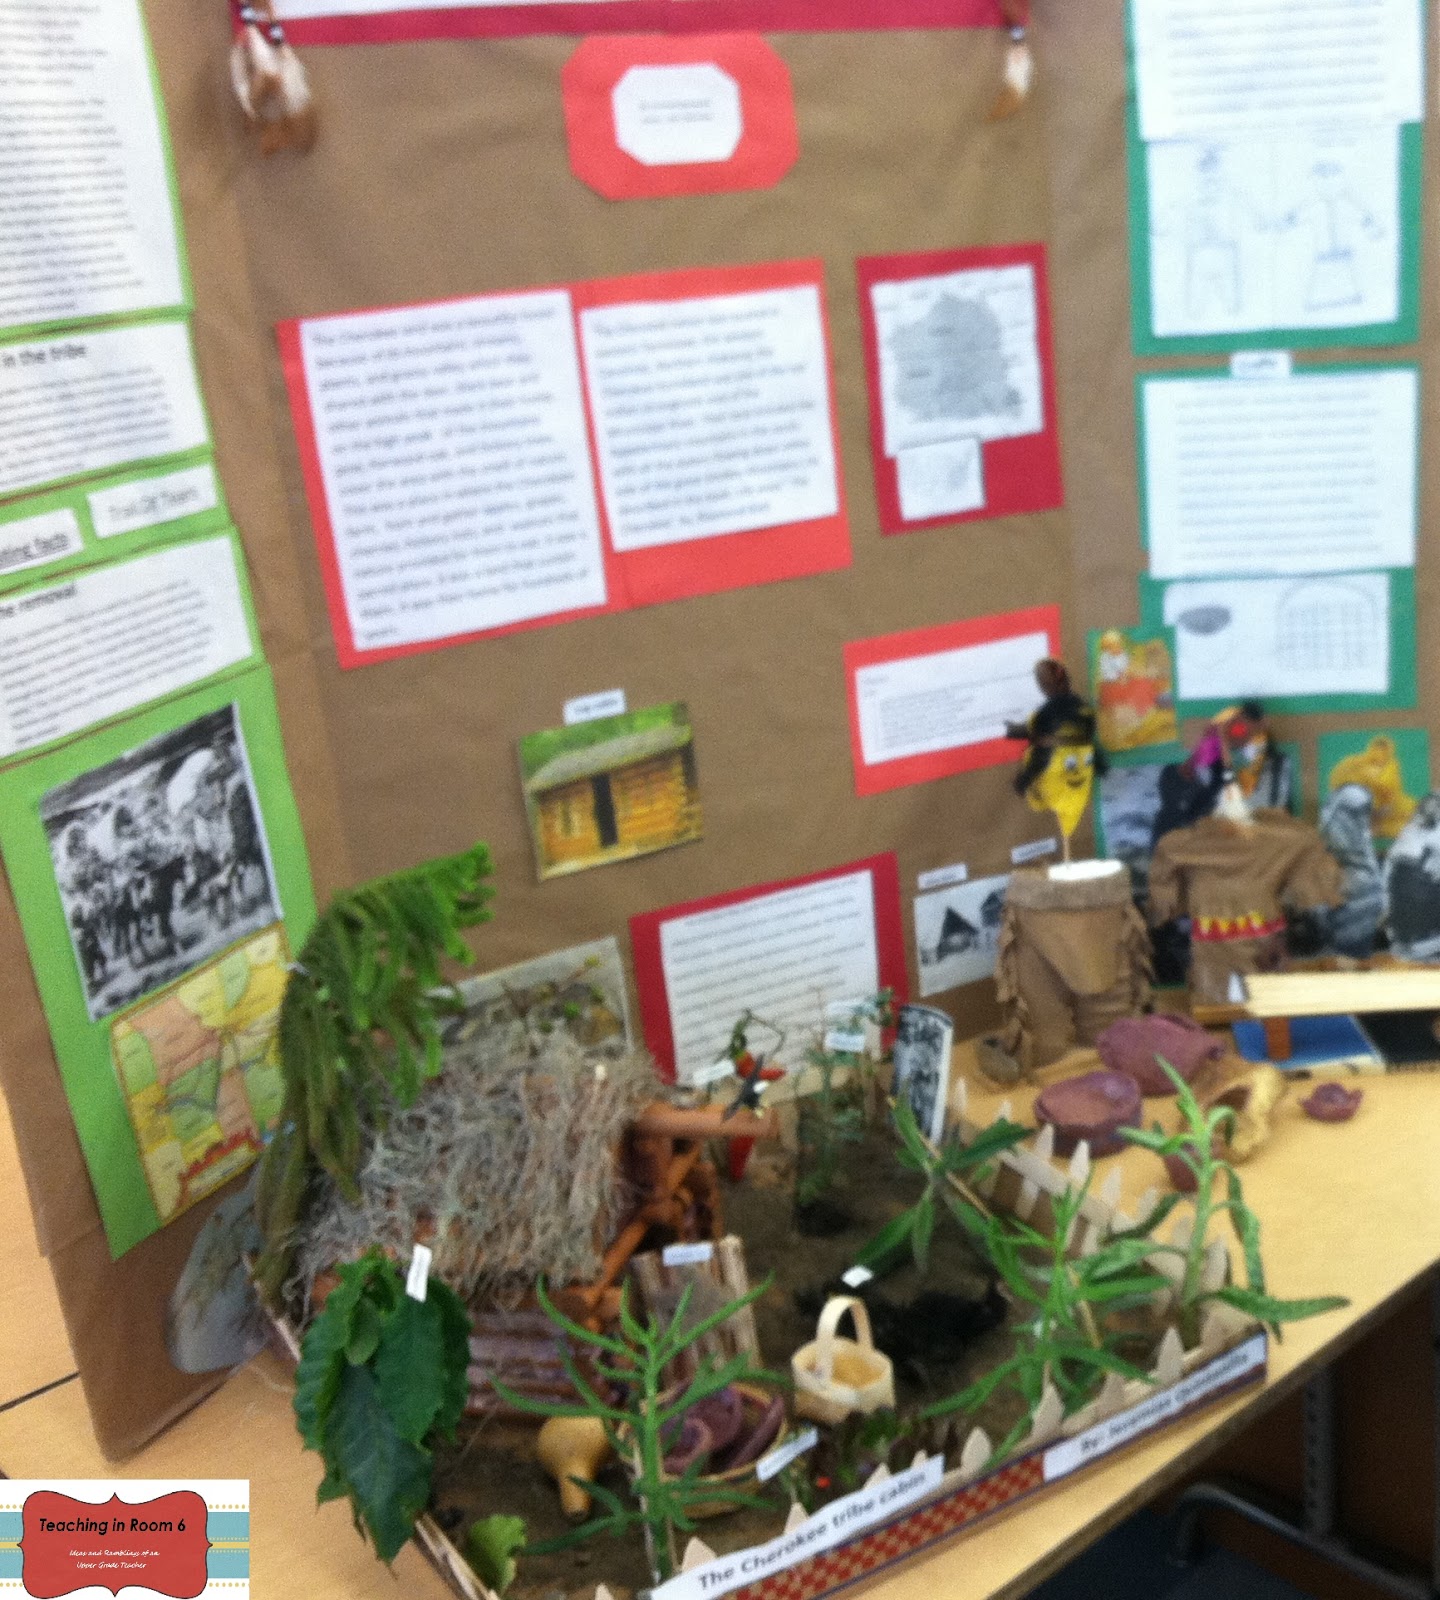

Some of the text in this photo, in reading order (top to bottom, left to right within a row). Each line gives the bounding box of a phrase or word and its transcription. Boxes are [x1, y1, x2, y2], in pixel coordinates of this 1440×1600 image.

[698, 1471, 927, 1591] The Cherokee tribe cabin
